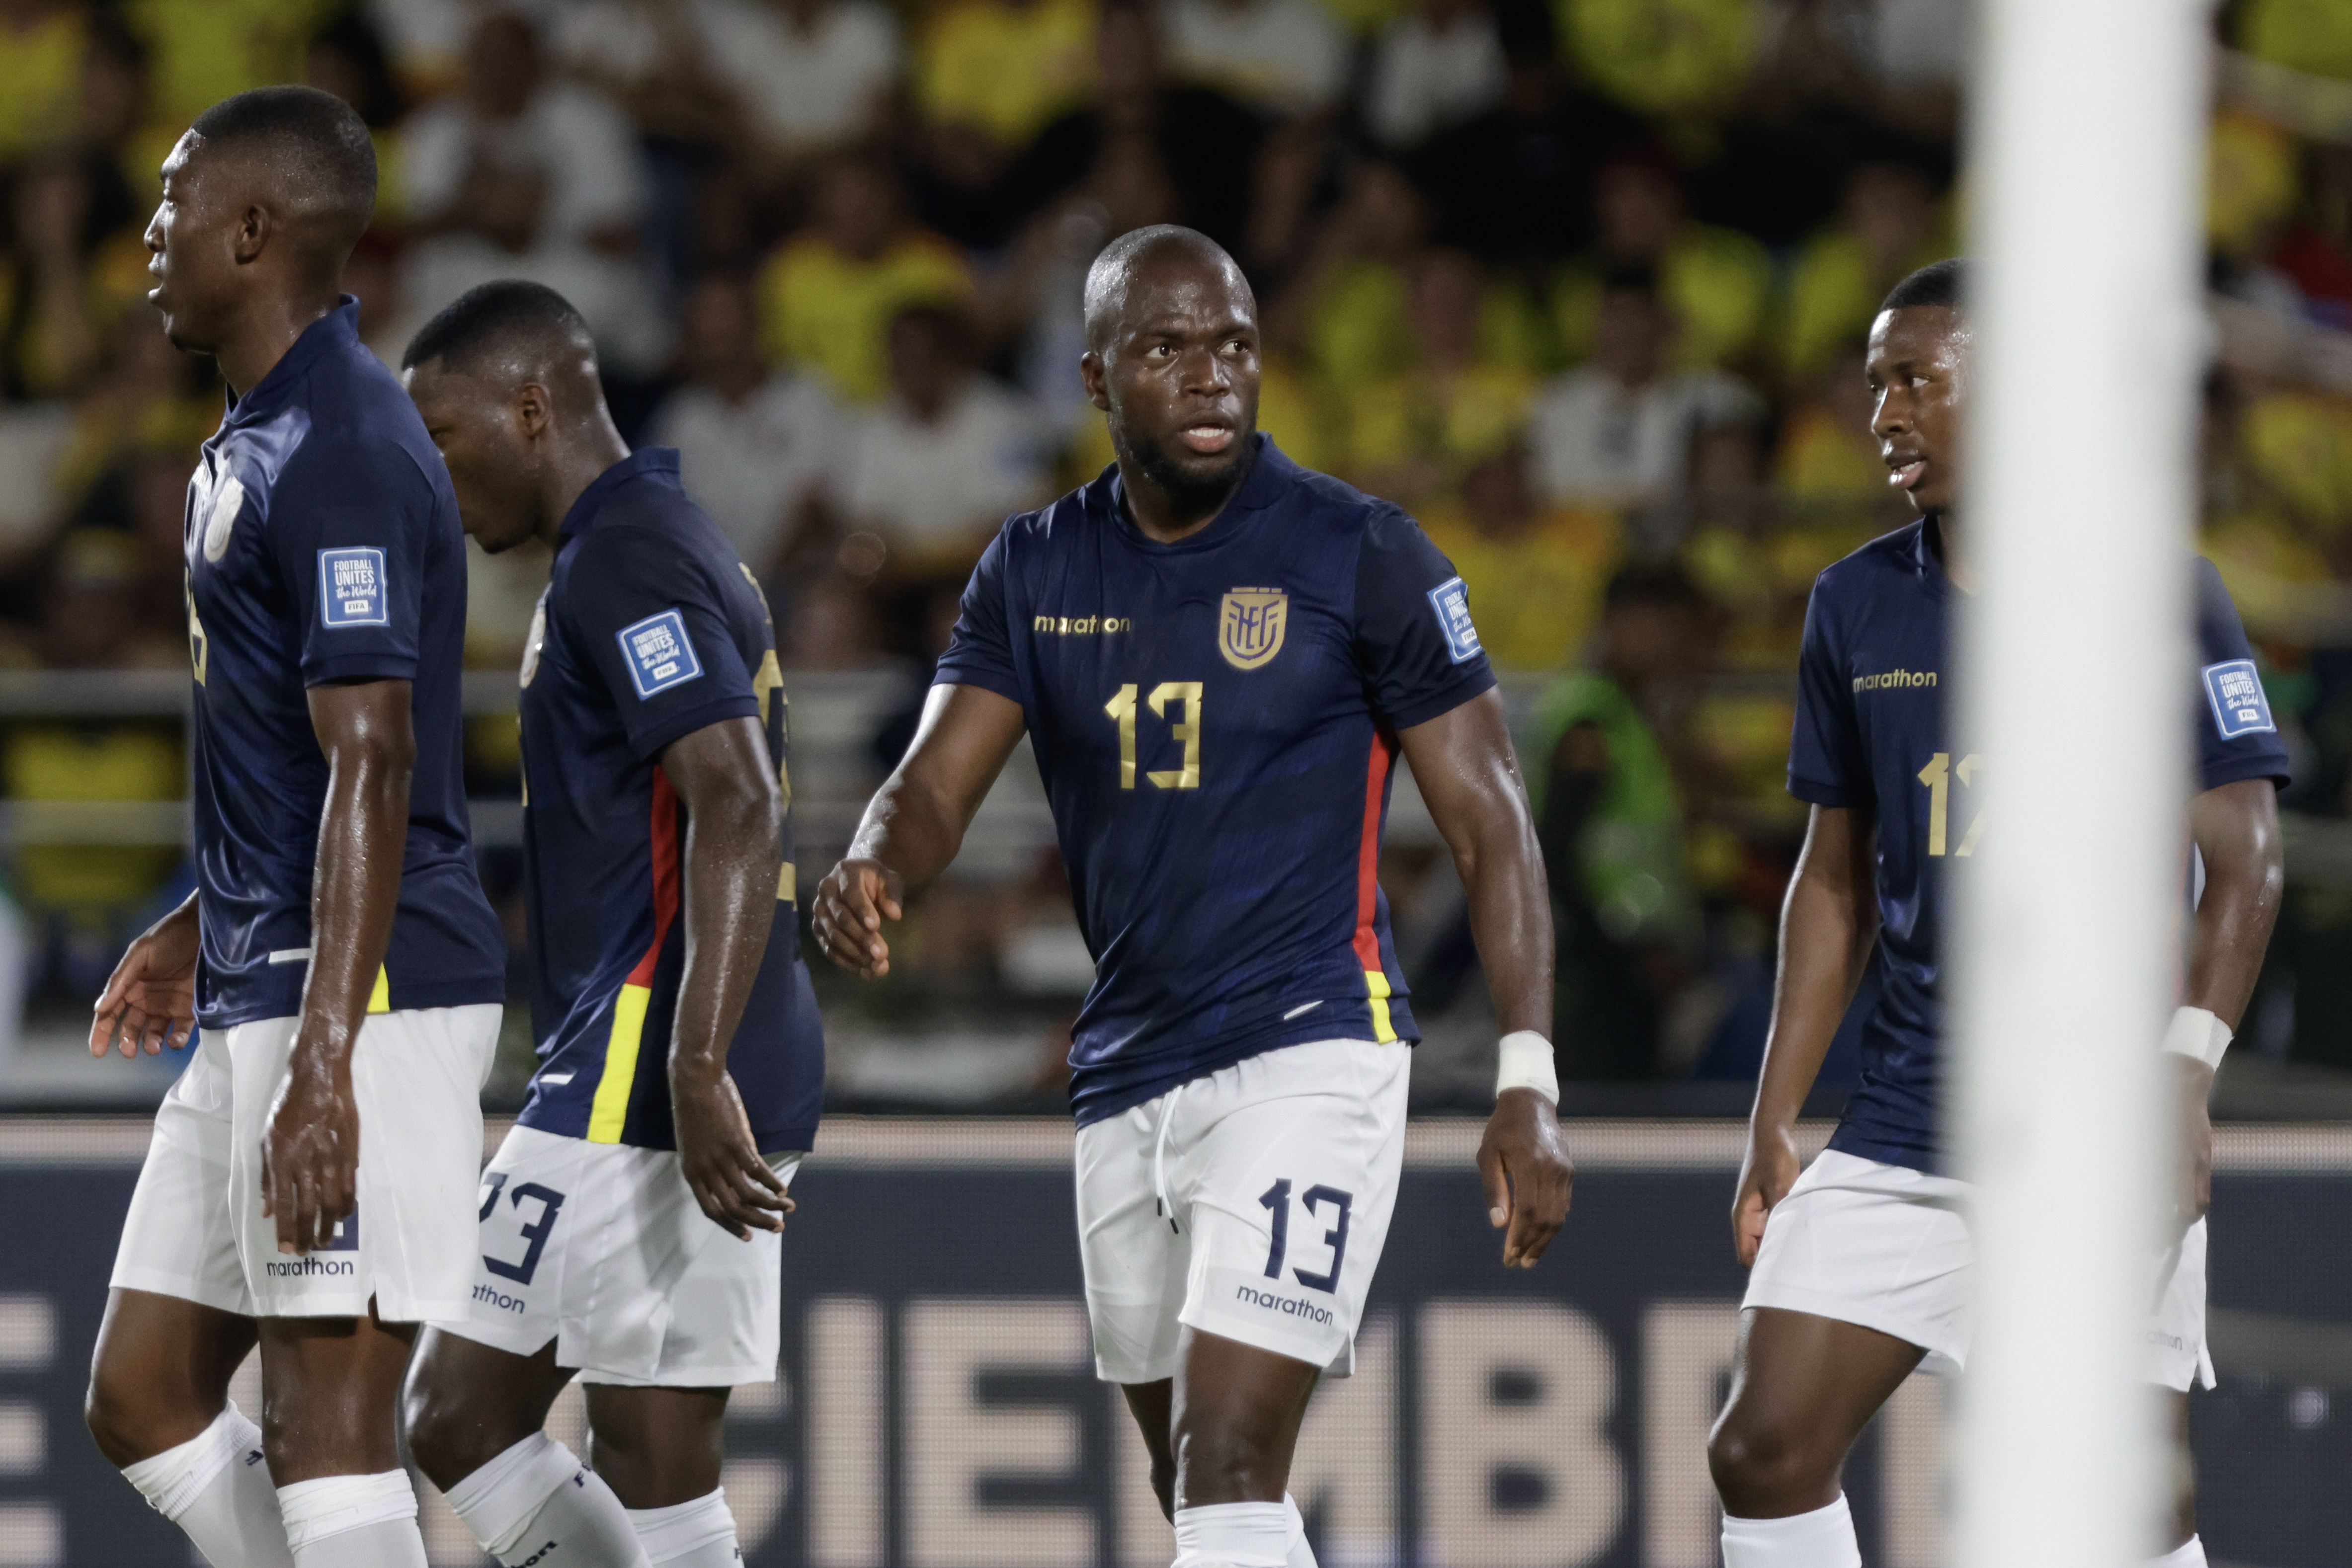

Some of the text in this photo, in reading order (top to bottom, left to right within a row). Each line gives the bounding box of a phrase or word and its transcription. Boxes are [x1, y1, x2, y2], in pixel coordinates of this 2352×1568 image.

[334, 559, 373, 571] FOOTBALL
[335, 570, 375, 585] UNITES
[335, 584, 377, 599] the World
[1034, 615, 1130, 634] maraton
[1463, 630, 1475, 641] FIFA
[1854, 669, 1937, 693] marathon
[2219, 671, 2252, 685] FOOTBALL
[2222, 681, 2256, 698] UNITES
[2227, 697, 2242, 710] the
[1105, 682, 1203, 789] 13
[1258, 1177, 1353, 1295] 13
[266, 1257, 353, 1276] marathon
[1237, 1285, 1334, 1326] marathon
